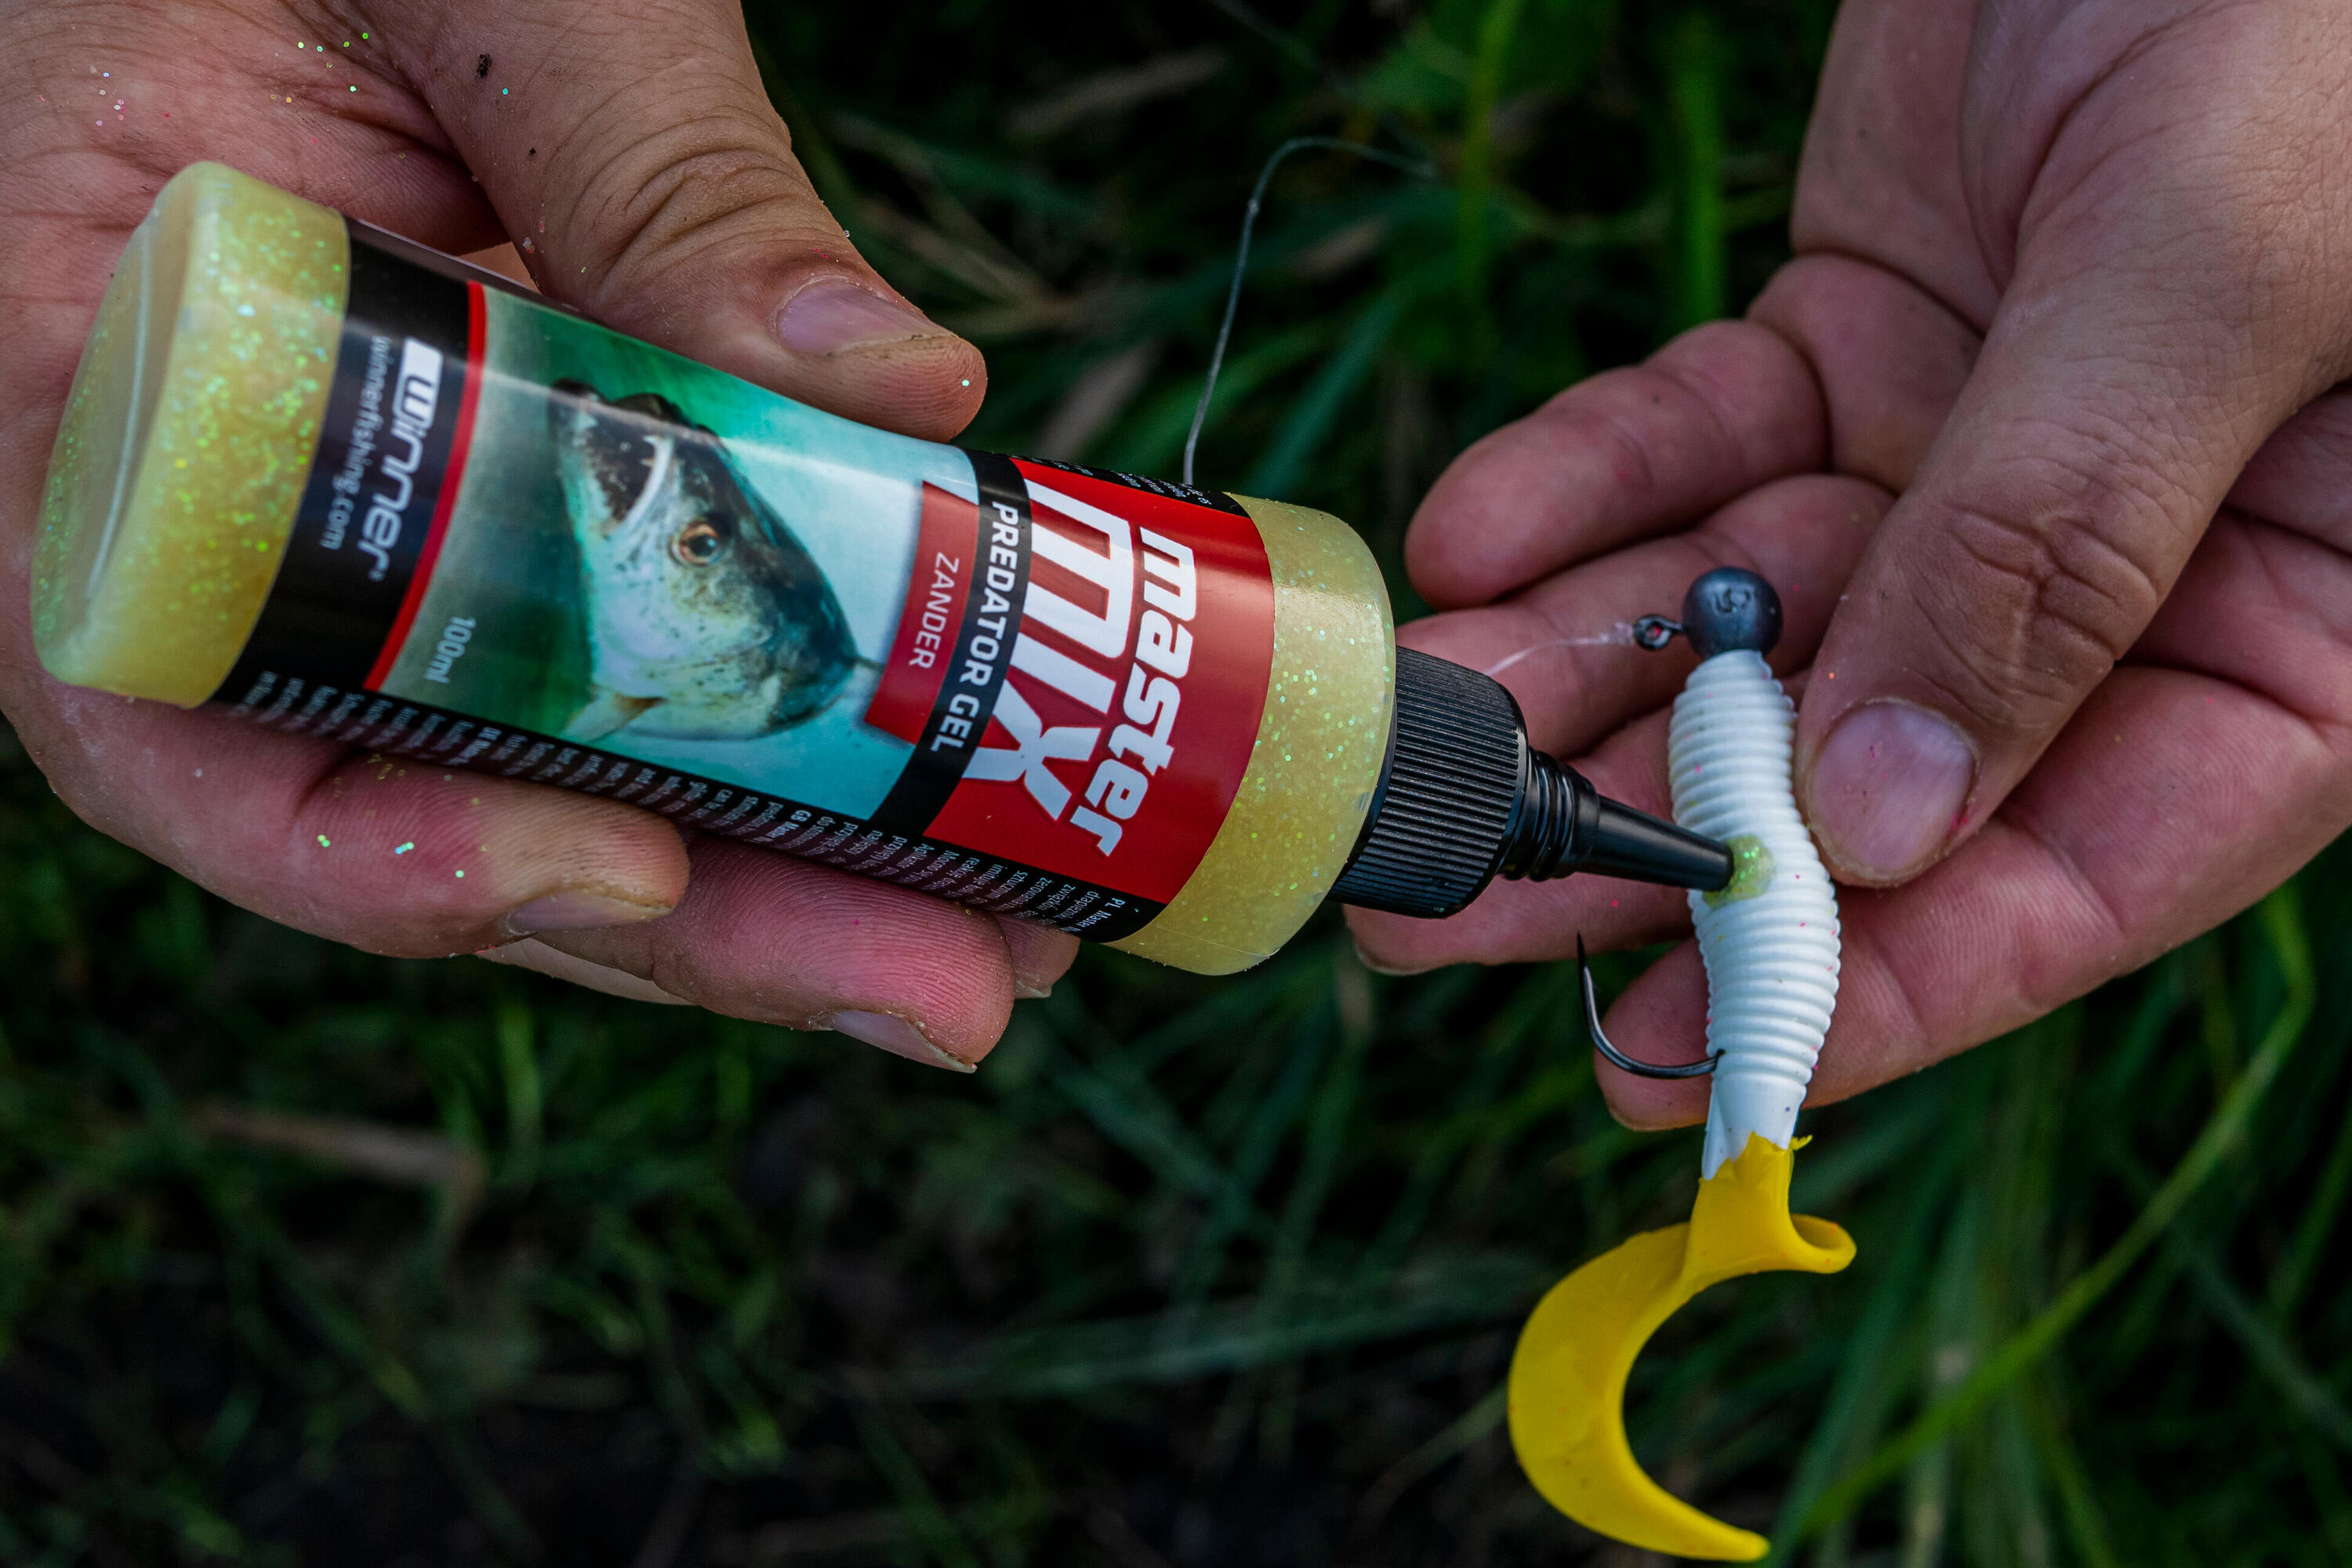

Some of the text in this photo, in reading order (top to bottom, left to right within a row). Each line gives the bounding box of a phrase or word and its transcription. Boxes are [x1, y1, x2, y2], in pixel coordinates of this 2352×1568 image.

[320, 336, 390, 550] winnerfishing.com
[909, 552, 959, 670] ZANDER
[930, 501, 1018, 752] PREDATOR GEL
[426, 616, 476, 684] 100ml
[790, 810, 812, 822] GB
[896, 843, 935, 869] Aplikator
[926, 850, 960, 871] Mocno
[1075, 898, 1126, 928] PL Master
